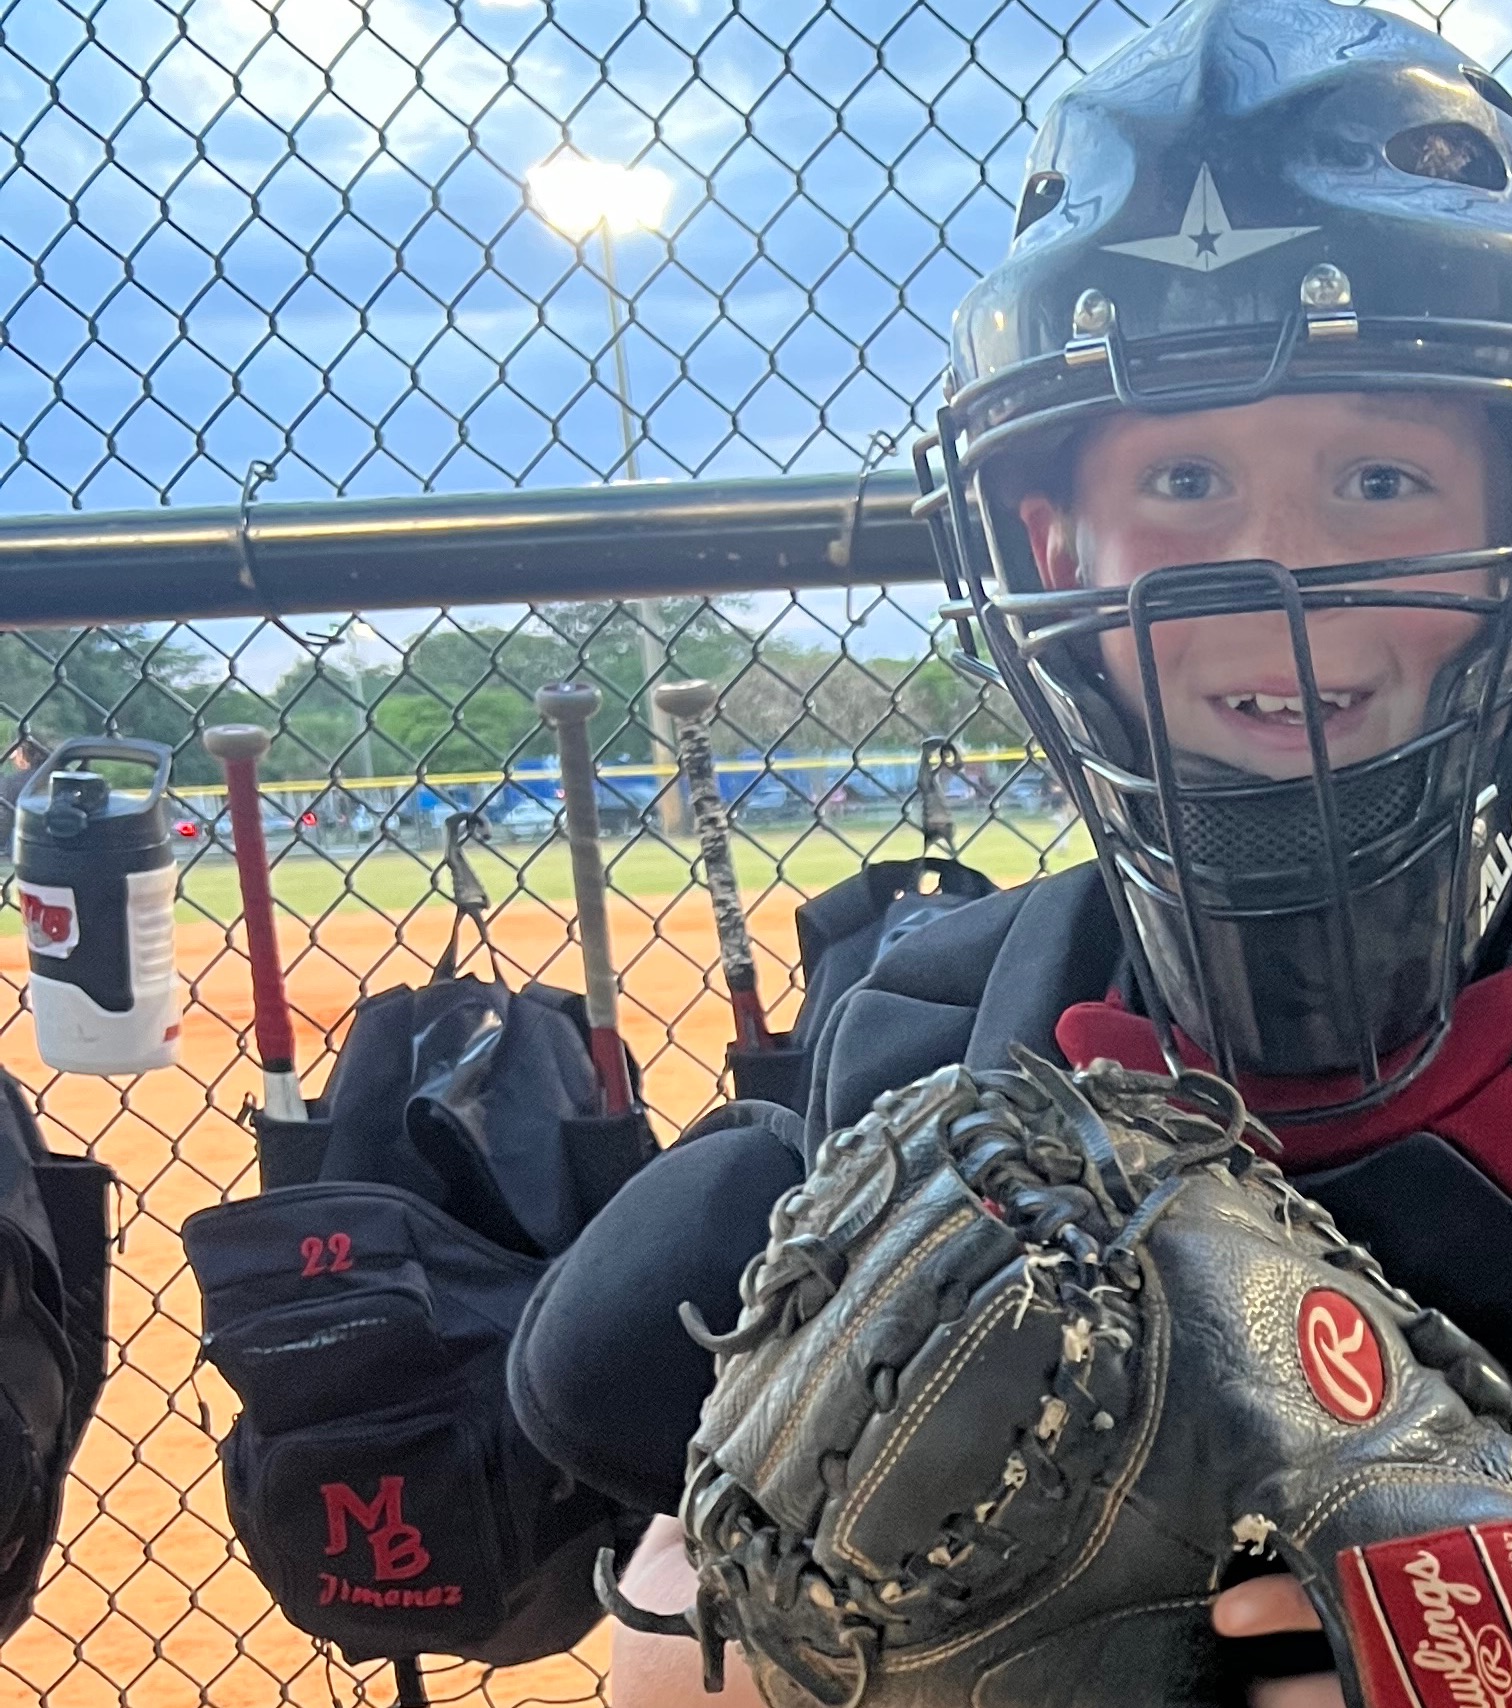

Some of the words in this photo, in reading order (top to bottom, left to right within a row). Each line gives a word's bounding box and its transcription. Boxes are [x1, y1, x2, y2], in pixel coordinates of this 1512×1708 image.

[300, 1233, 353, 1278] 22
[1307, 1305, 1374, 1417] R
[320, 1475, 431, 1581] MB
[1403, 1550, 1490, 1708] wlings
